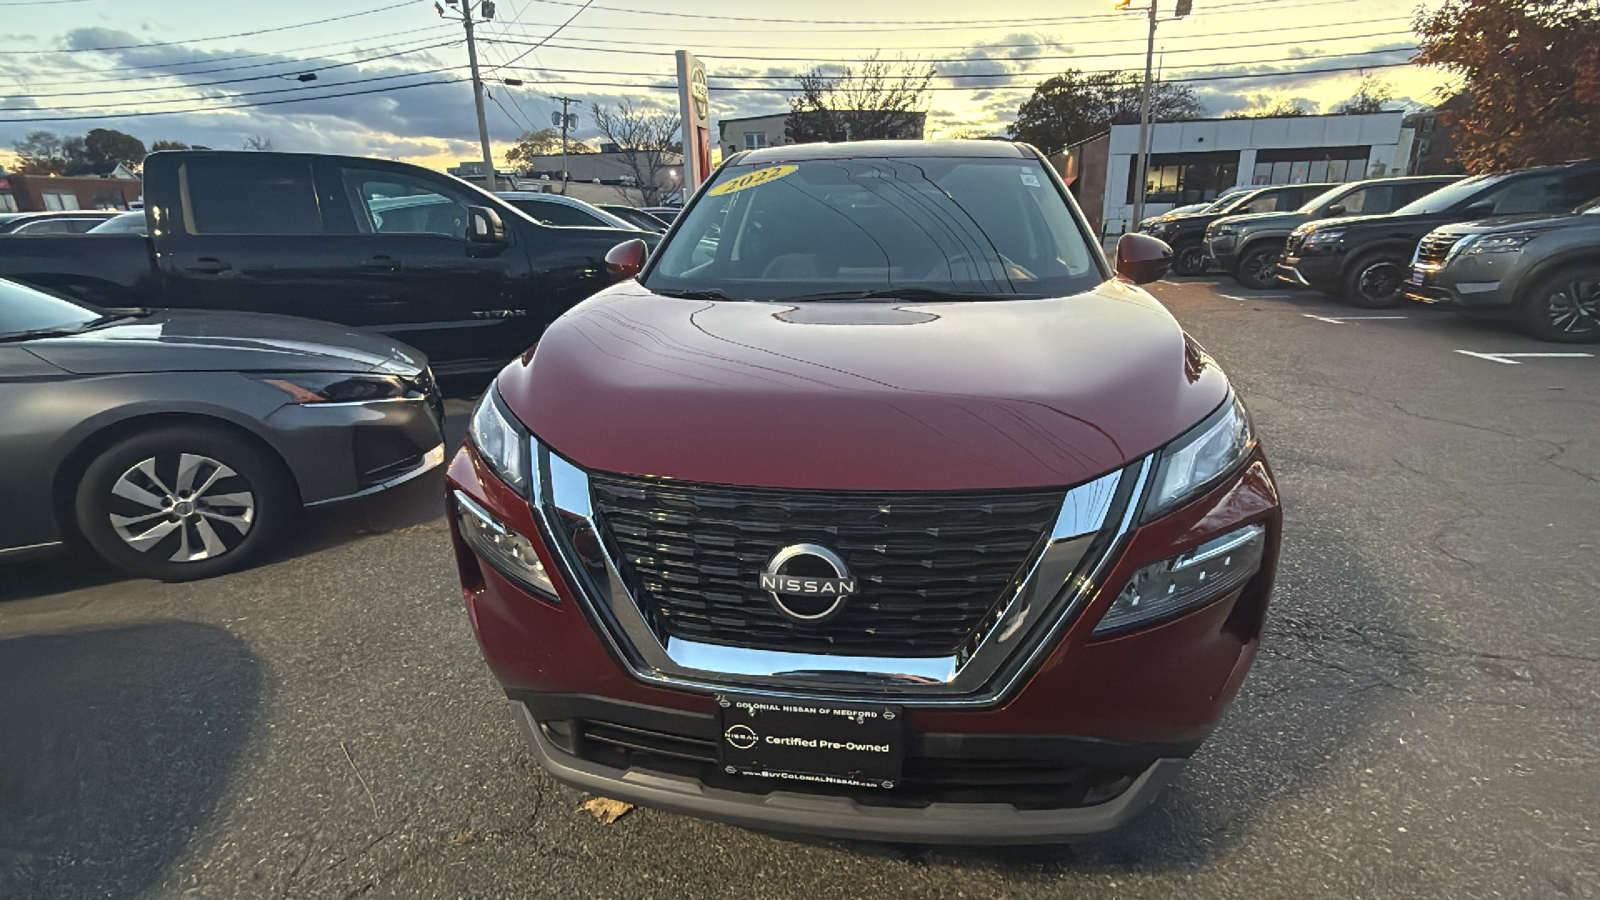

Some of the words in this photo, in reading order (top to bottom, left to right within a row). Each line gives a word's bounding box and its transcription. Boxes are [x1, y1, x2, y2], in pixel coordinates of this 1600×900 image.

[724, 168, 781, 192] 2022
[762, 576, 854, 593] NISSAN
[736, 702, 780, 711] COLONIAL
[783, 706, 817, 714] NISSAN
[833, 709, 878, 718] MEDFORD
[724, 732, 759, 741] NISSAN
[765, 736, 817, 747] Certified
[819, 740, 889, 752] Pre-Owned
